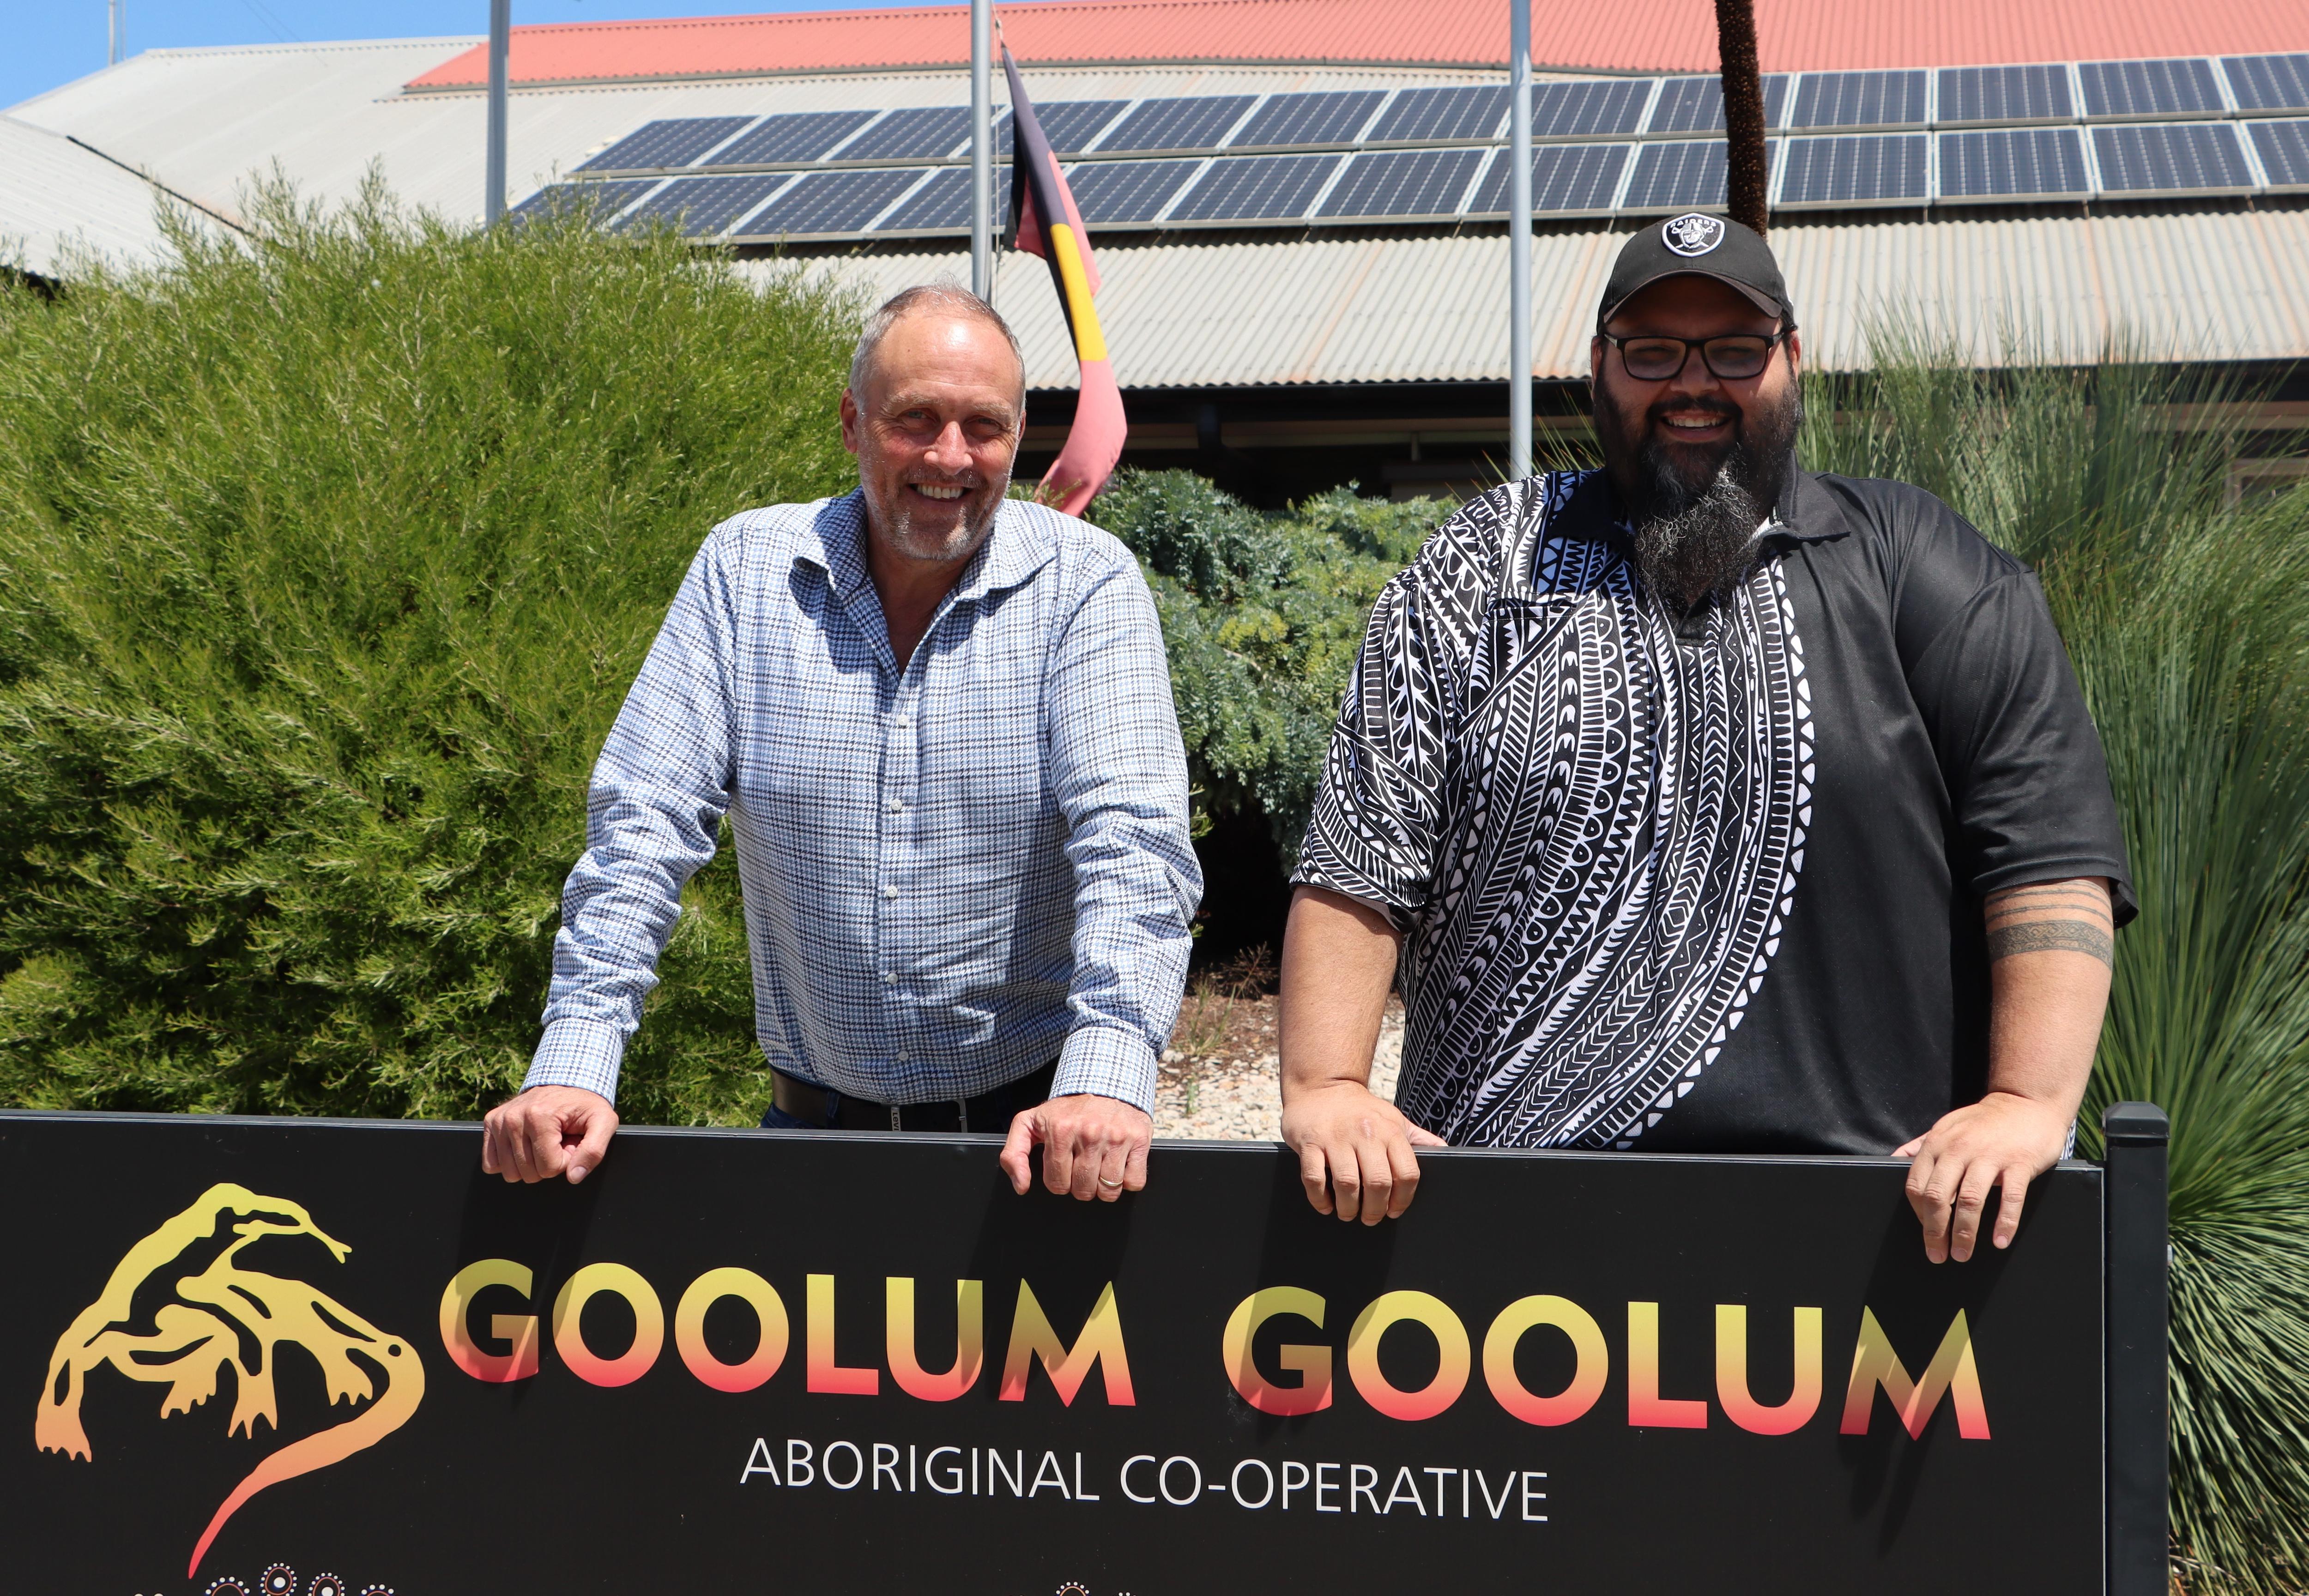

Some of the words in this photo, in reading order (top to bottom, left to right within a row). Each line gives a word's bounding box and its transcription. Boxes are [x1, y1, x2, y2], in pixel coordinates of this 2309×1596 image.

[1670, 218, 1717, 228] RAIDERS
[439, 1258, 1137, 1409] GOOLUM
[1221, 1285, 1992, 1442] GOOLUM
[739, 1437, 1100, 1501] ABORIGINAL
[1120, 1454, 1548, 1522] CO-OPERATIVE
